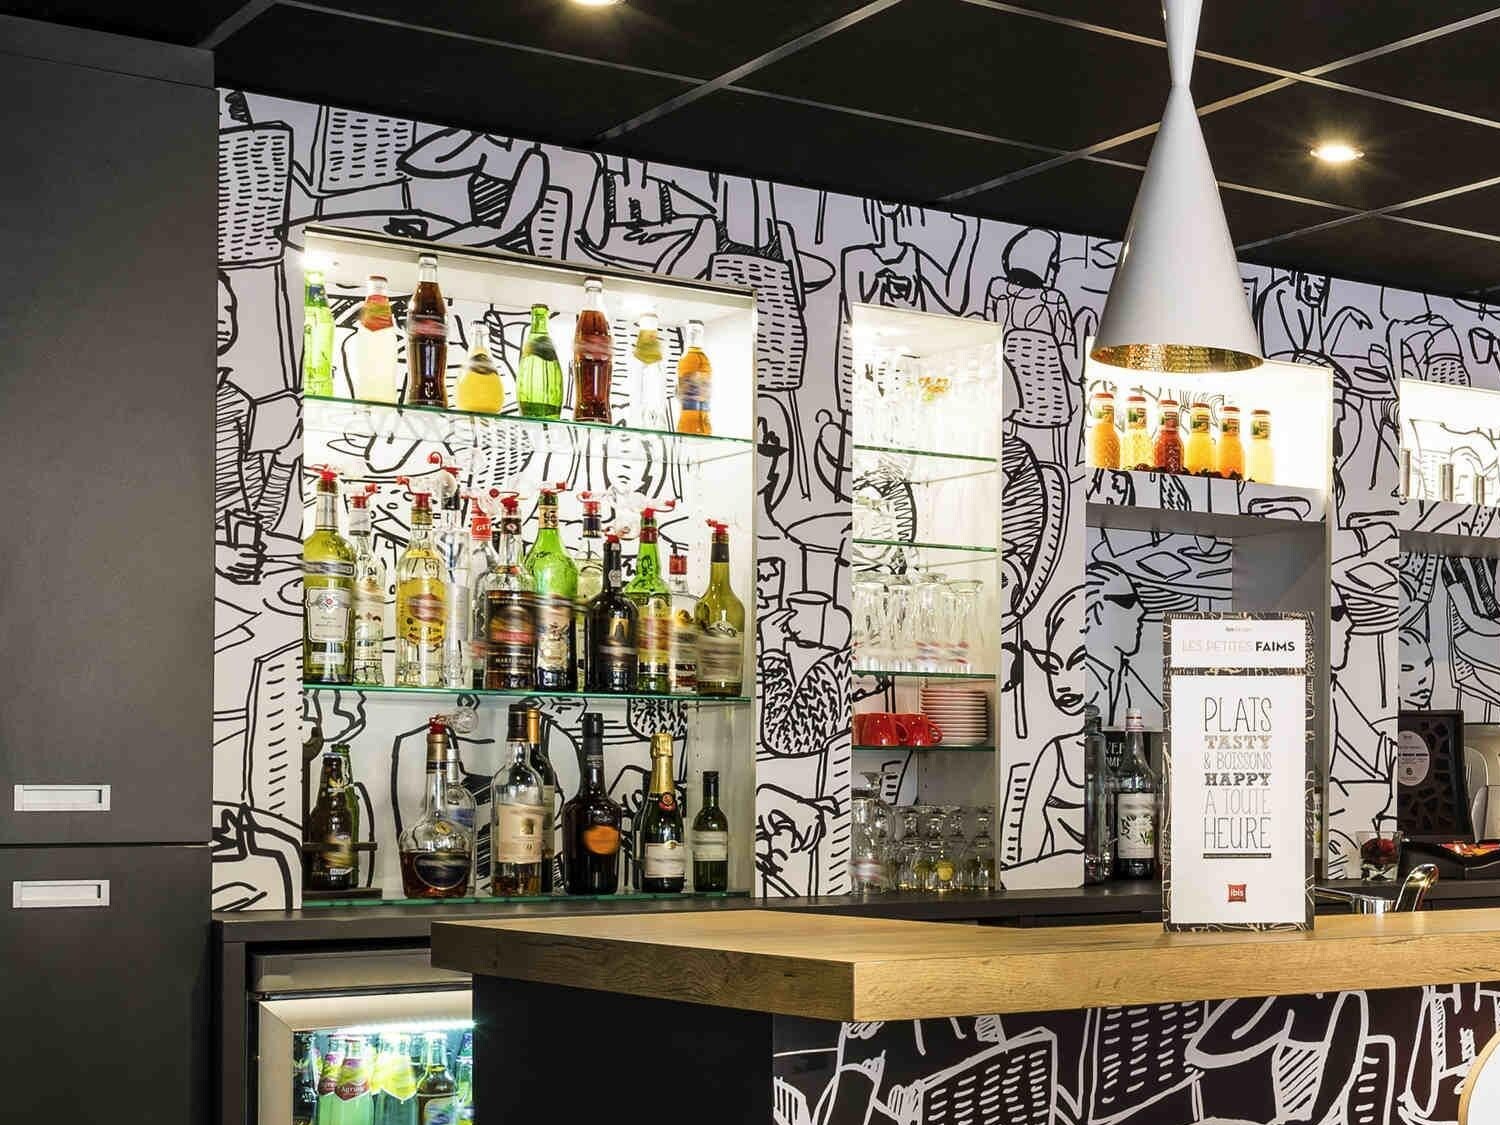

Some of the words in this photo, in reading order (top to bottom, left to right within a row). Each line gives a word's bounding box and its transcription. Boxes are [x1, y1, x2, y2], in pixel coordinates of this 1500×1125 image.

[1255, 641, 1296, 652] FAIMS
[1203, 695, 1272, 732] PLATS
[1204, 735, 1272, 749] TASTY
[1217, 752, 1272, 770] BOISSONS
[1204, 772, 1272, 786] HAPPY
[1224, 788, 1272, 814] TOUTE
[1203, 816, 1272, 849] HEURE
